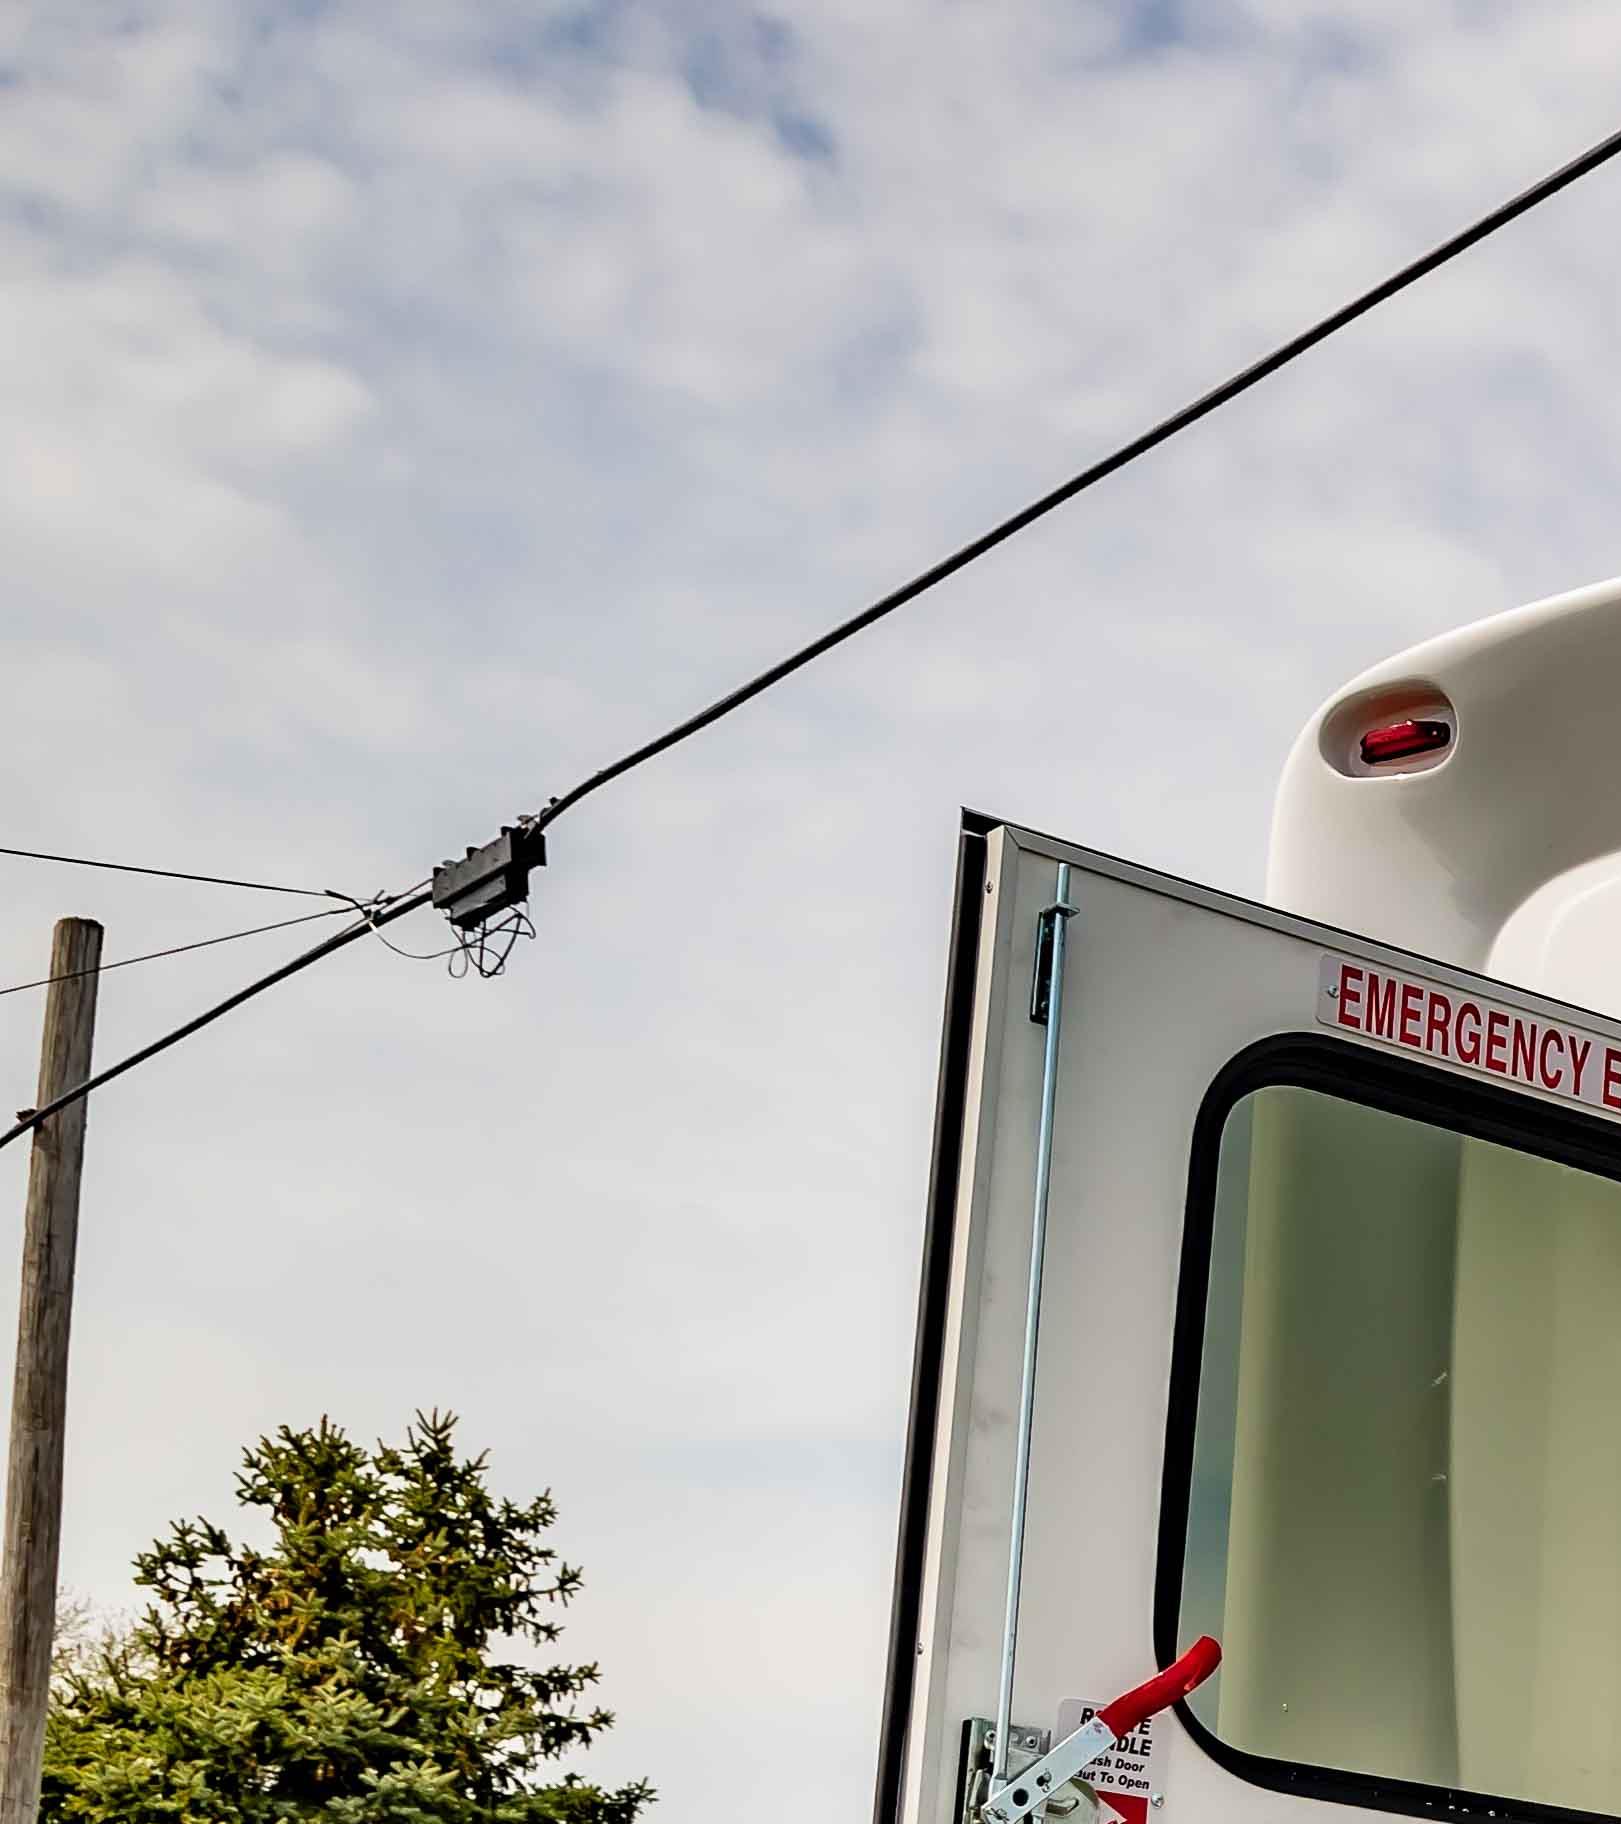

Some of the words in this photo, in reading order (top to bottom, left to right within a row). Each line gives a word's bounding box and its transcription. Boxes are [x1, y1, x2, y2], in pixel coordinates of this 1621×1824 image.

[1338, 964, 1591, 1096] EMERGENCY
[1109, 1736, 1152, 1756] DLE
[1090, 1756, 1111, 1768] ush
[1115, 1758, 1144, 1773] Door
[1100, 1771, 1115, 1784] To
[1118, 1775, 1150, 1790] Open
